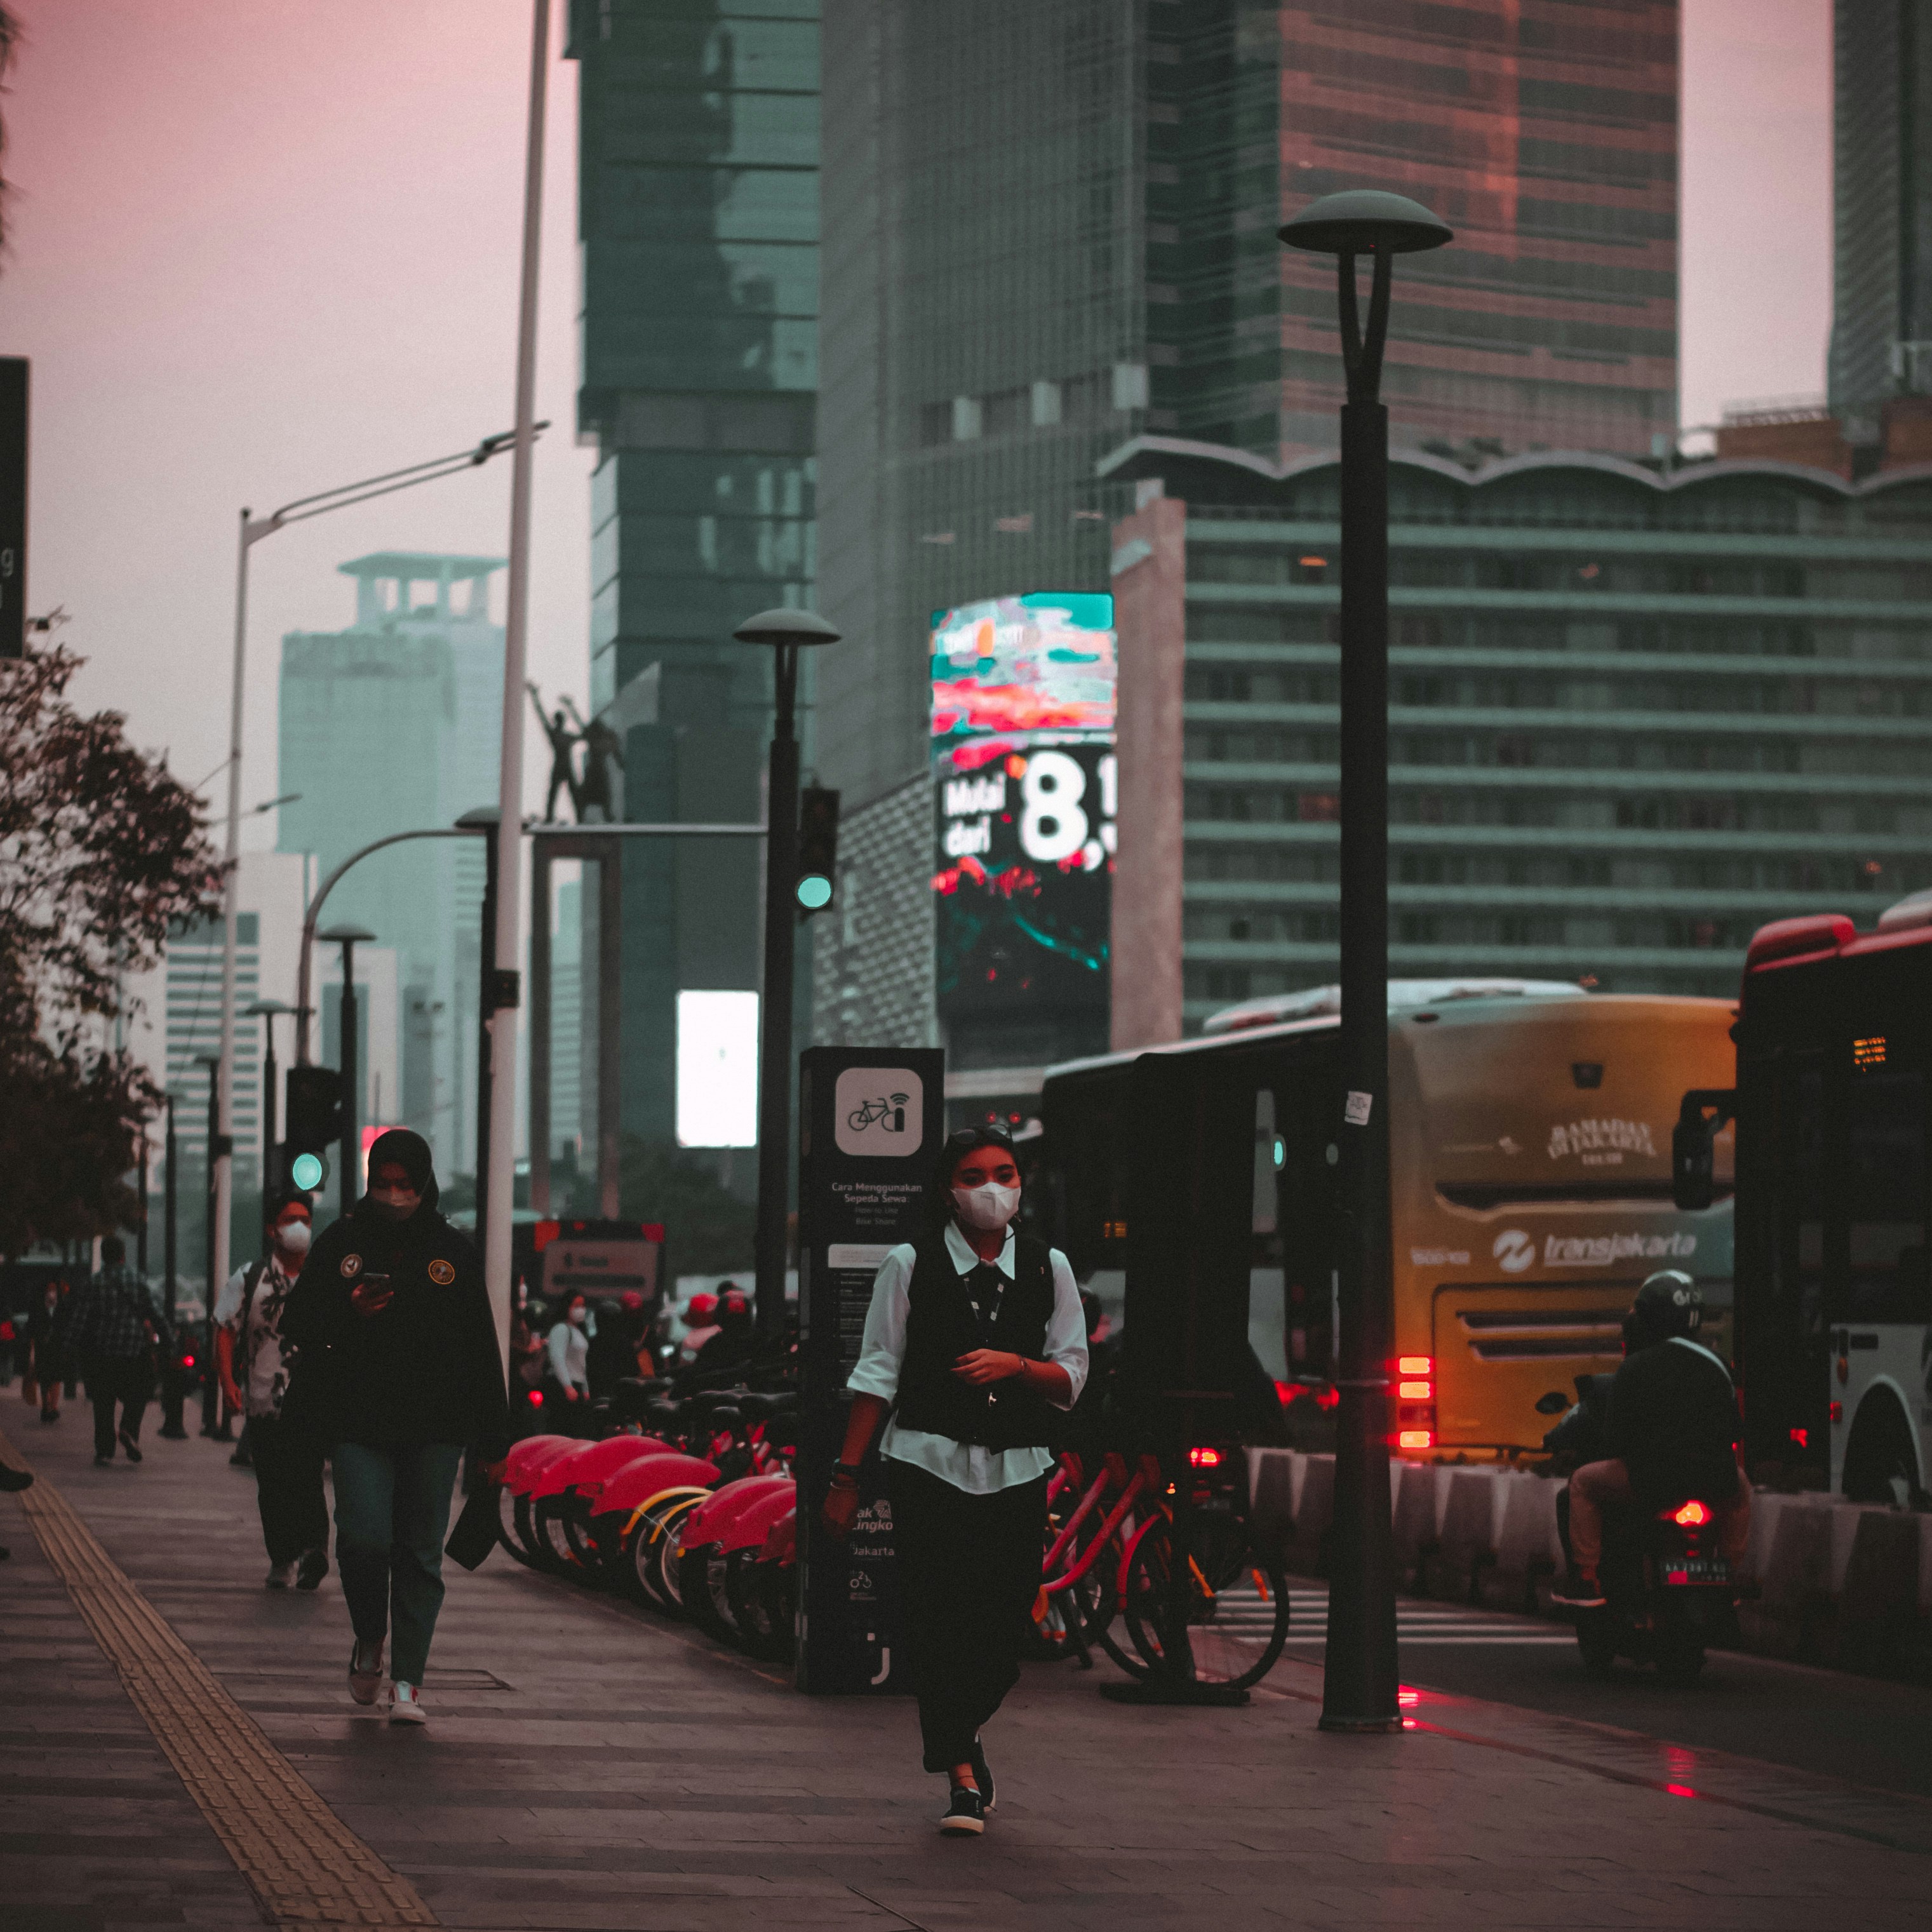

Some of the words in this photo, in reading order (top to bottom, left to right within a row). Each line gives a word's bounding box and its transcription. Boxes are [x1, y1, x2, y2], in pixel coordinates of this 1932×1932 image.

[831, 1182, 852, 1191] Cara
[855, 1183, 922, 1193] Menggunakan
[844, 1194, 878, 1204] Sepeda
[882, 1194, 907, 1203] Sewa
[1544, 1233, 1697, 1266] transjakarta
[853, 1545, 895, 1556] Jakarta
